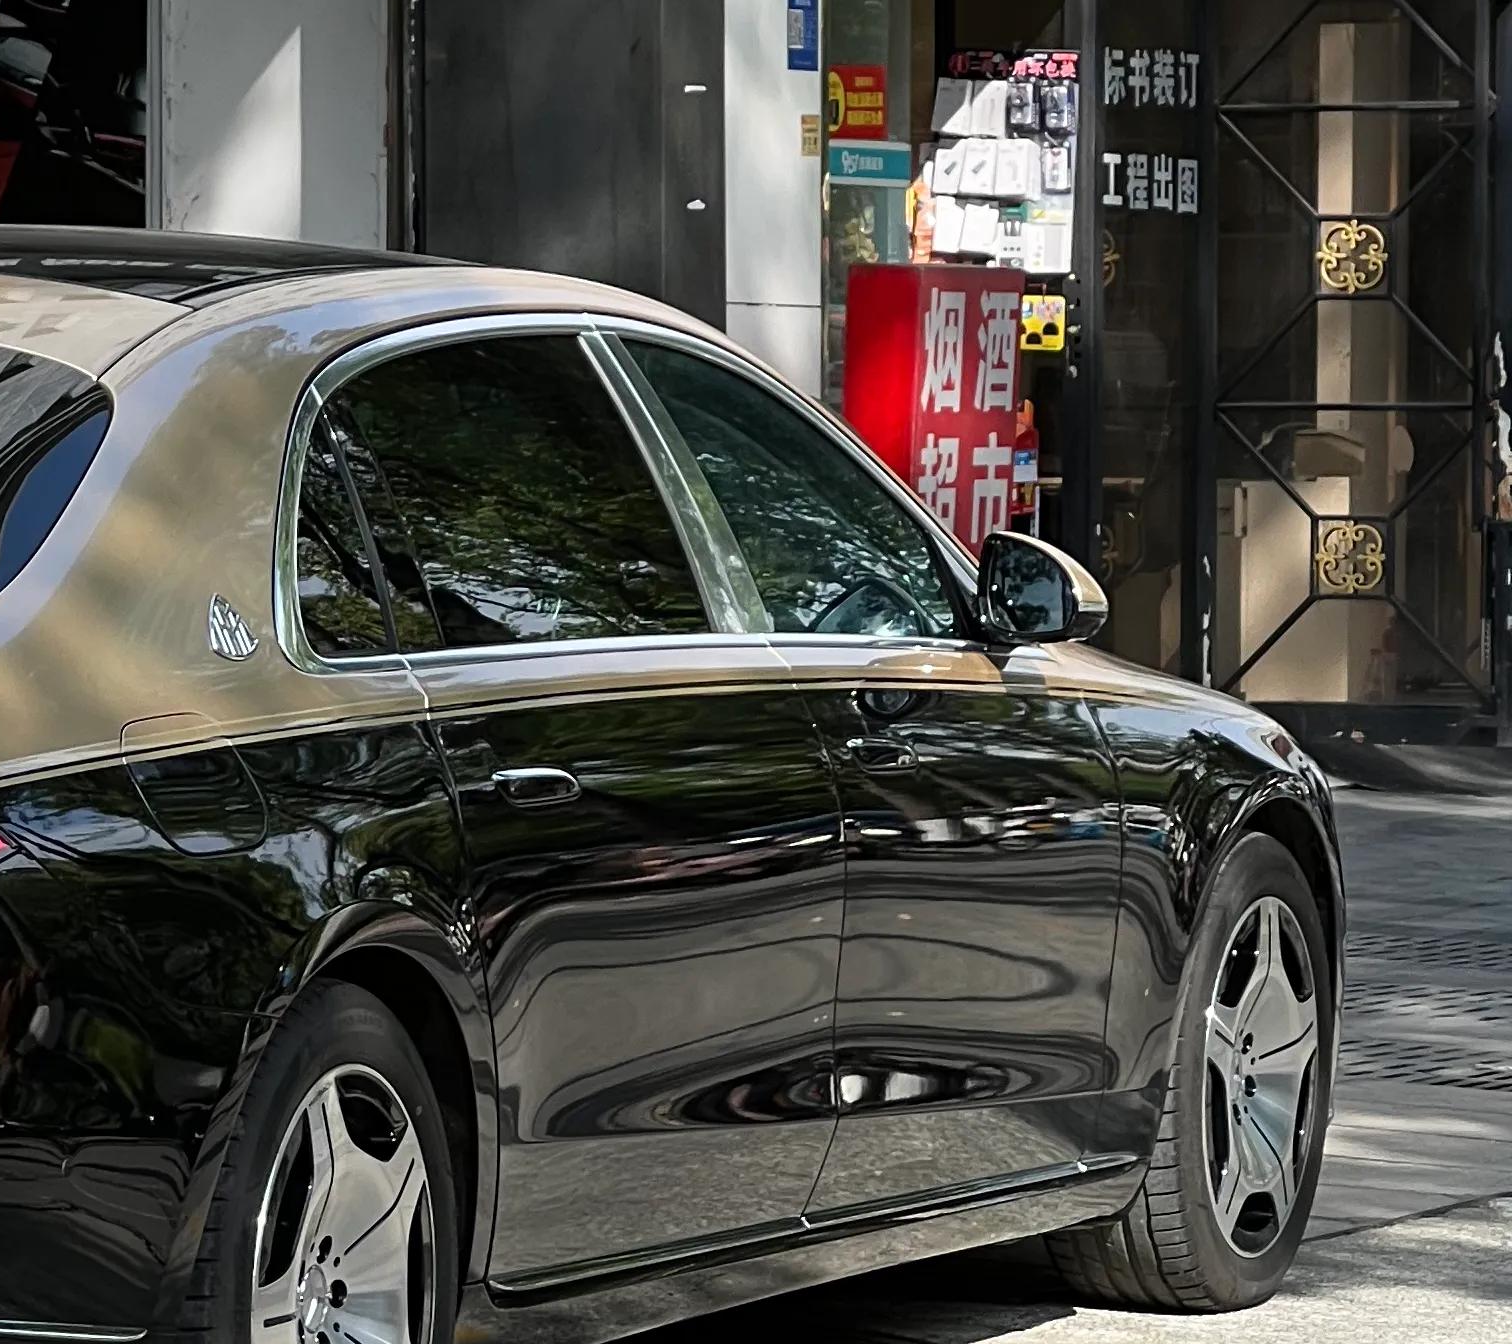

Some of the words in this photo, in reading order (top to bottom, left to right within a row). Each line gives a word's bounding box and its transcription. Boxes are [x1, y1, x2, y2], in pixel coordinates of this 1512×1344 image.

[1102, 152, 1199, 215] 工程出图
[920, 287, 1019, 413] 烟酒
[918, 432, 1013, 544] 超市
